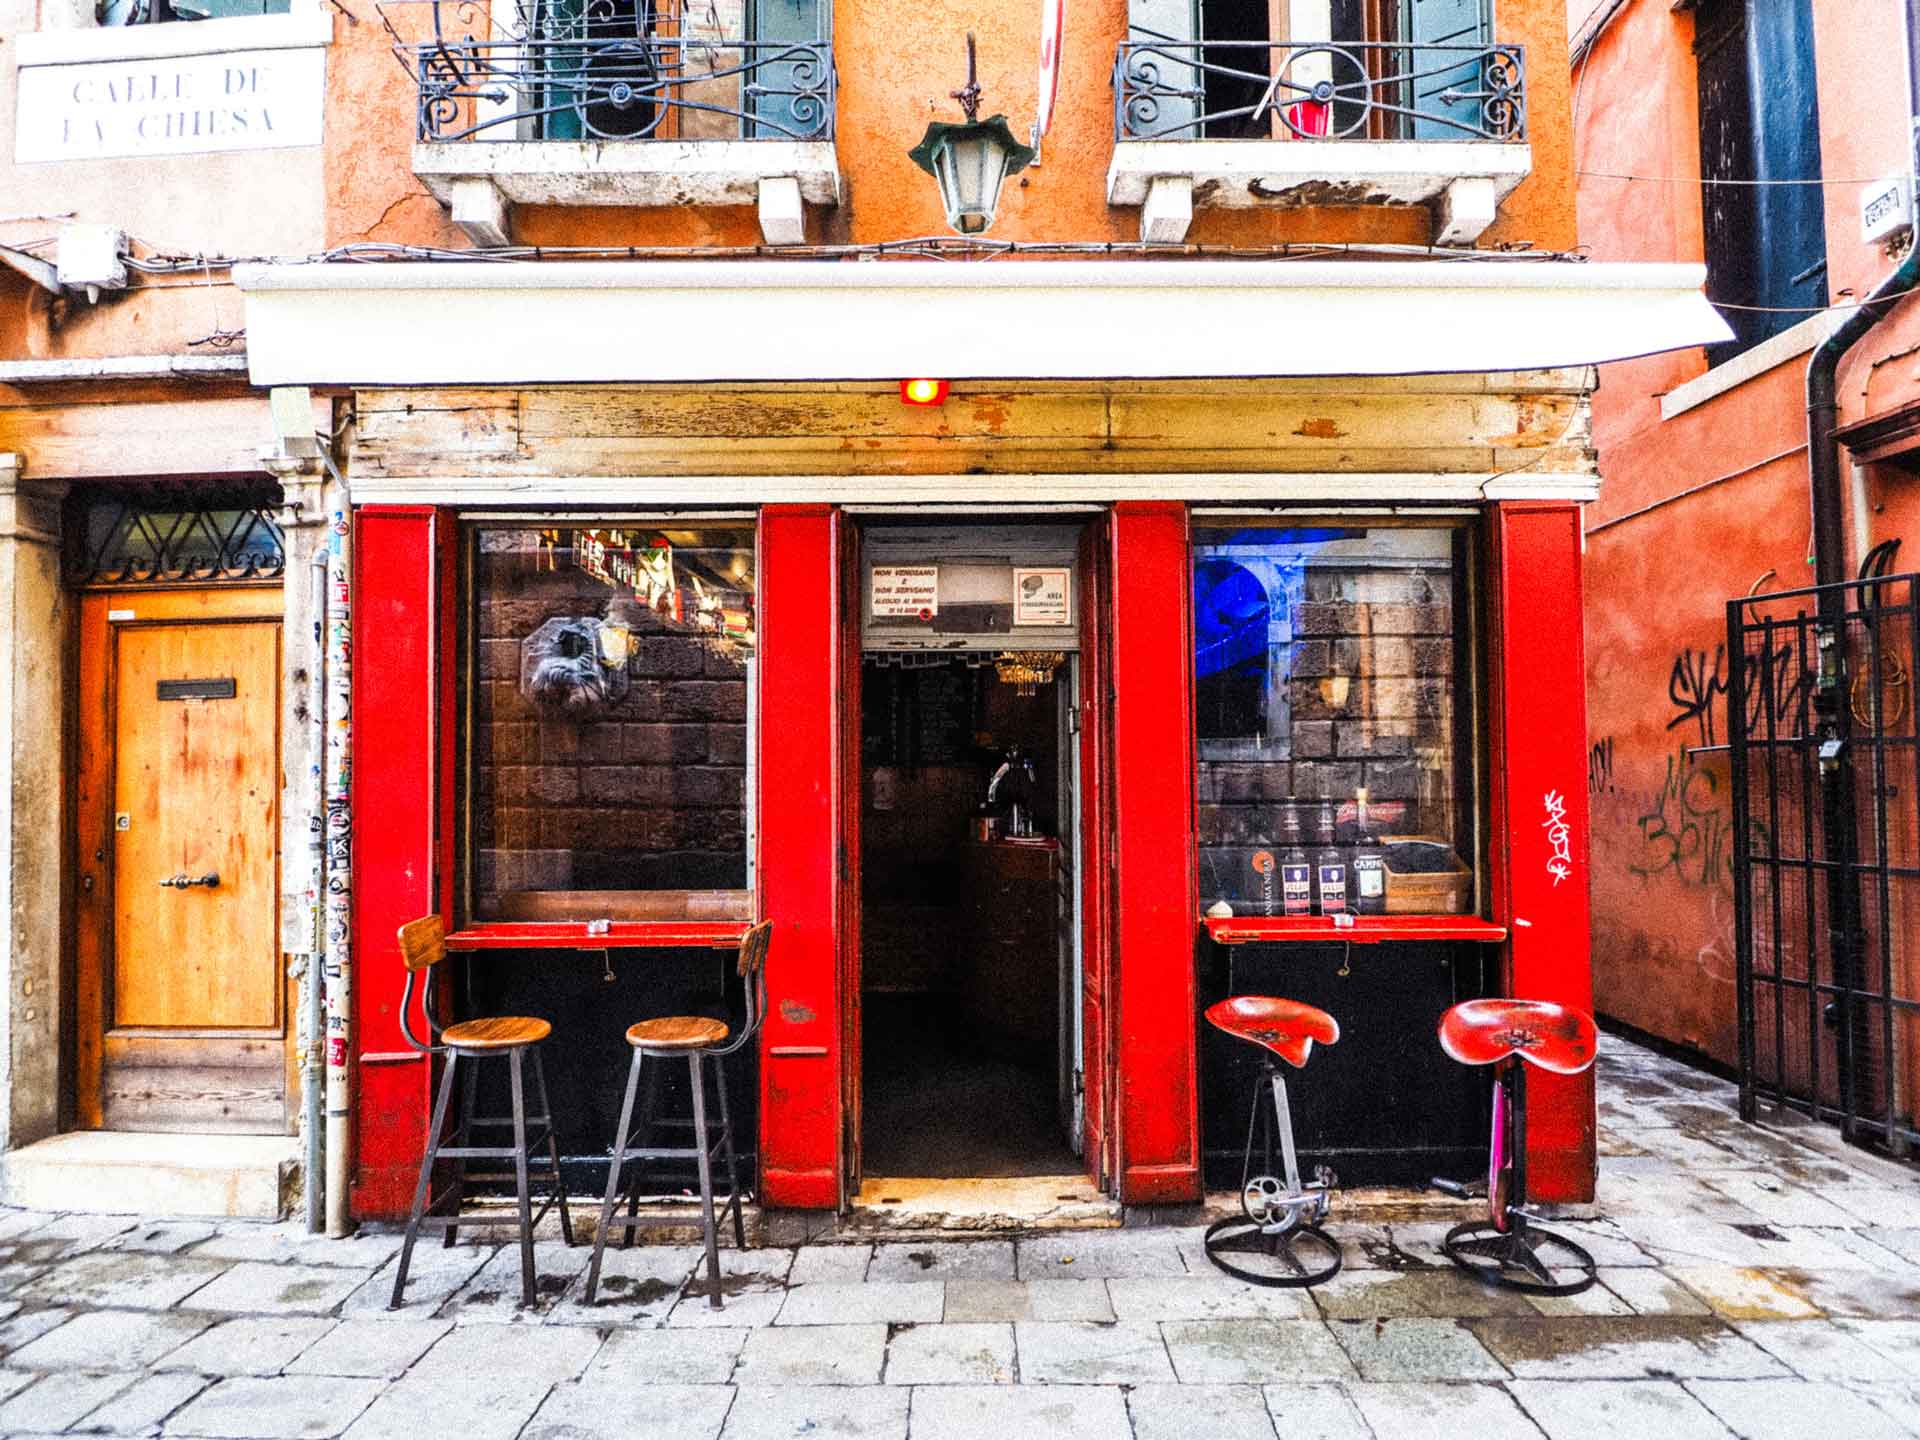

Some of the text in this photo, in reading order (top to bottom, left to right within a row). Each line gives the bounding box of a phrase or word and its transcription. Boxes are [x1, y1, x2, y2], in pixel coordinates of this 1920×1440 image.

[72, 67, 274, 104] CALLE DE
[63, 107, 275, 144] LA CHIESA
